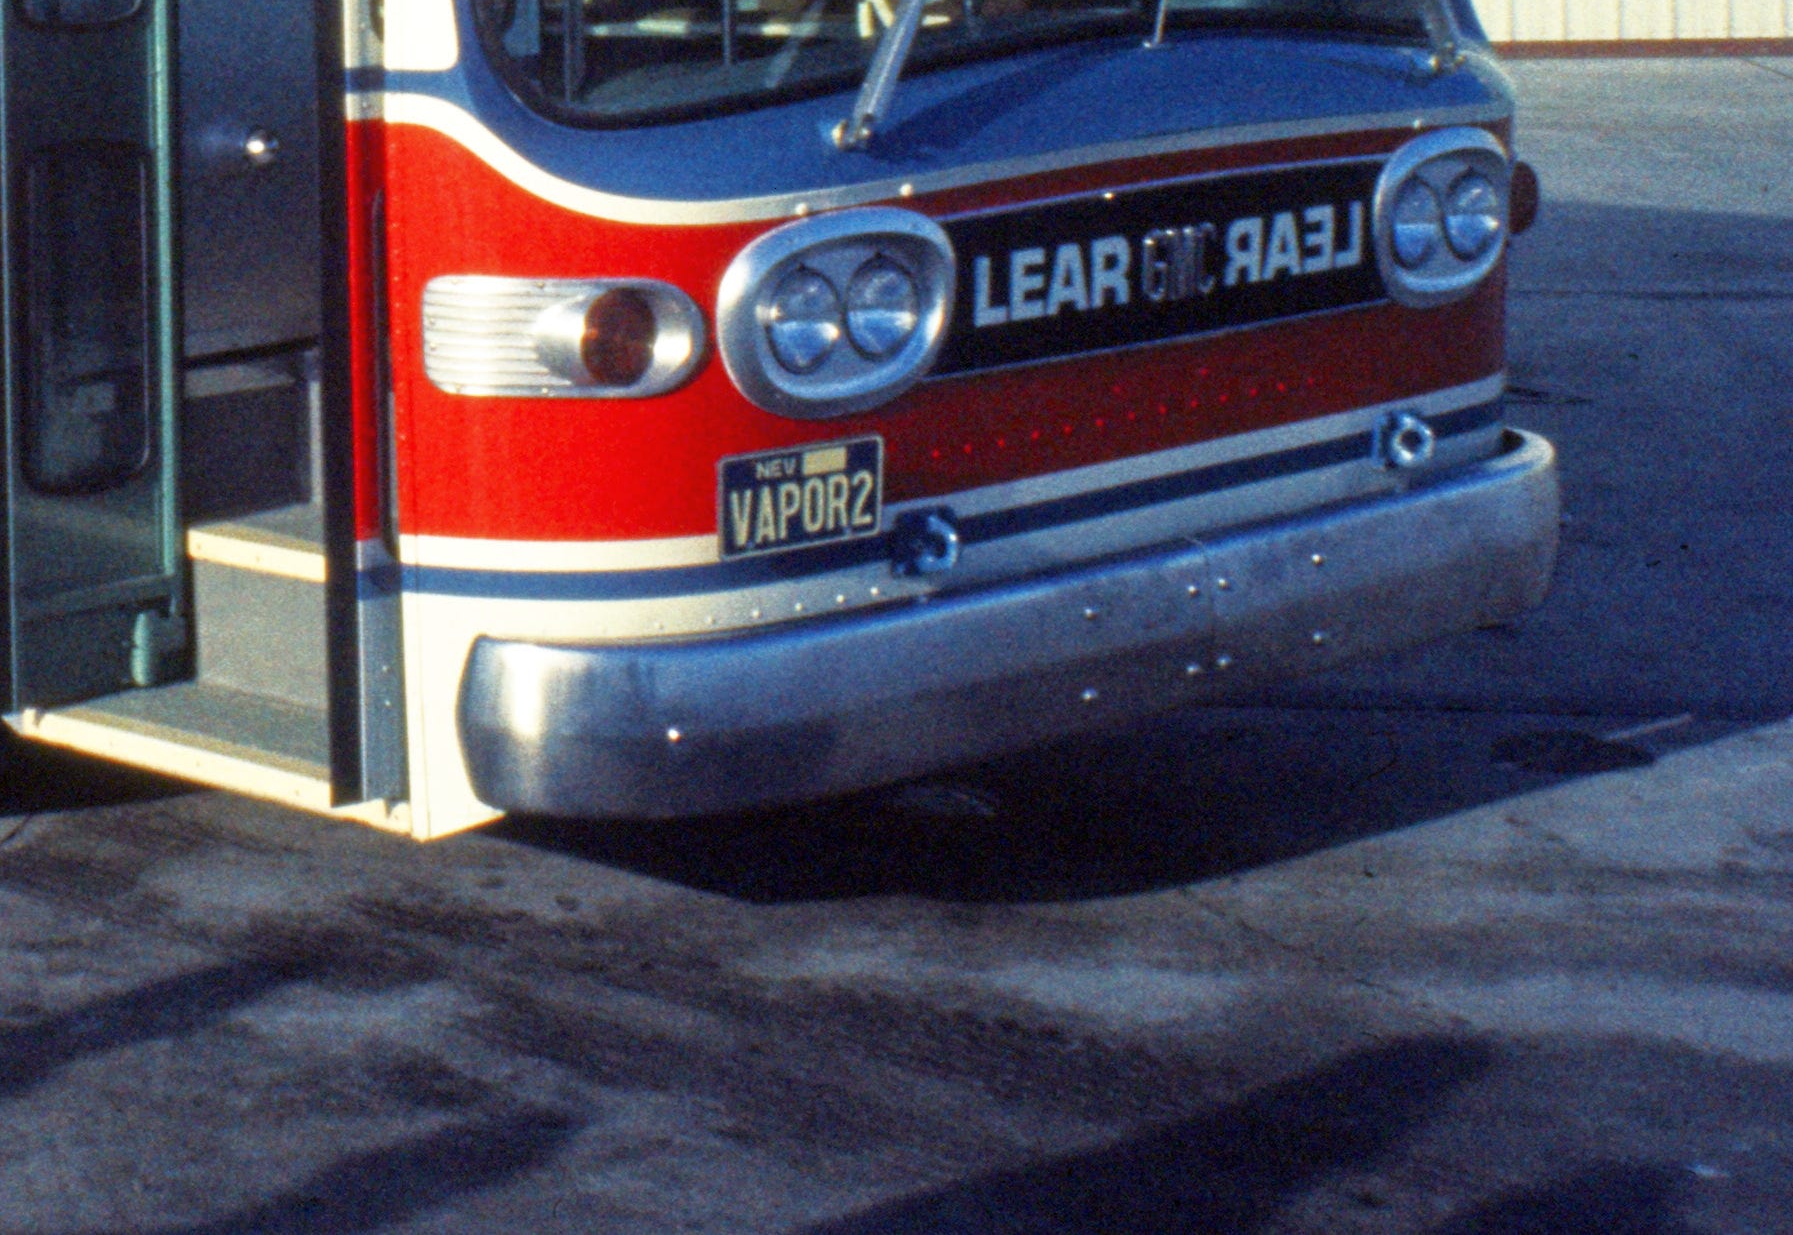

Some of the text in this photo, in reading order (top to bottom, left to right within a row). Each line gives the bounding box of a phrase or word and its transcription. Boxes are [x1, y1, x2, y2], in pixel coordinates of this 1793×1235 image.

[973, 235, 1130, 328] LEAR
[1142, 222, 1216, 302] GMC
[756, 458, 796, 479] NEV
[730, 470, 874, 547] VAPOR2
